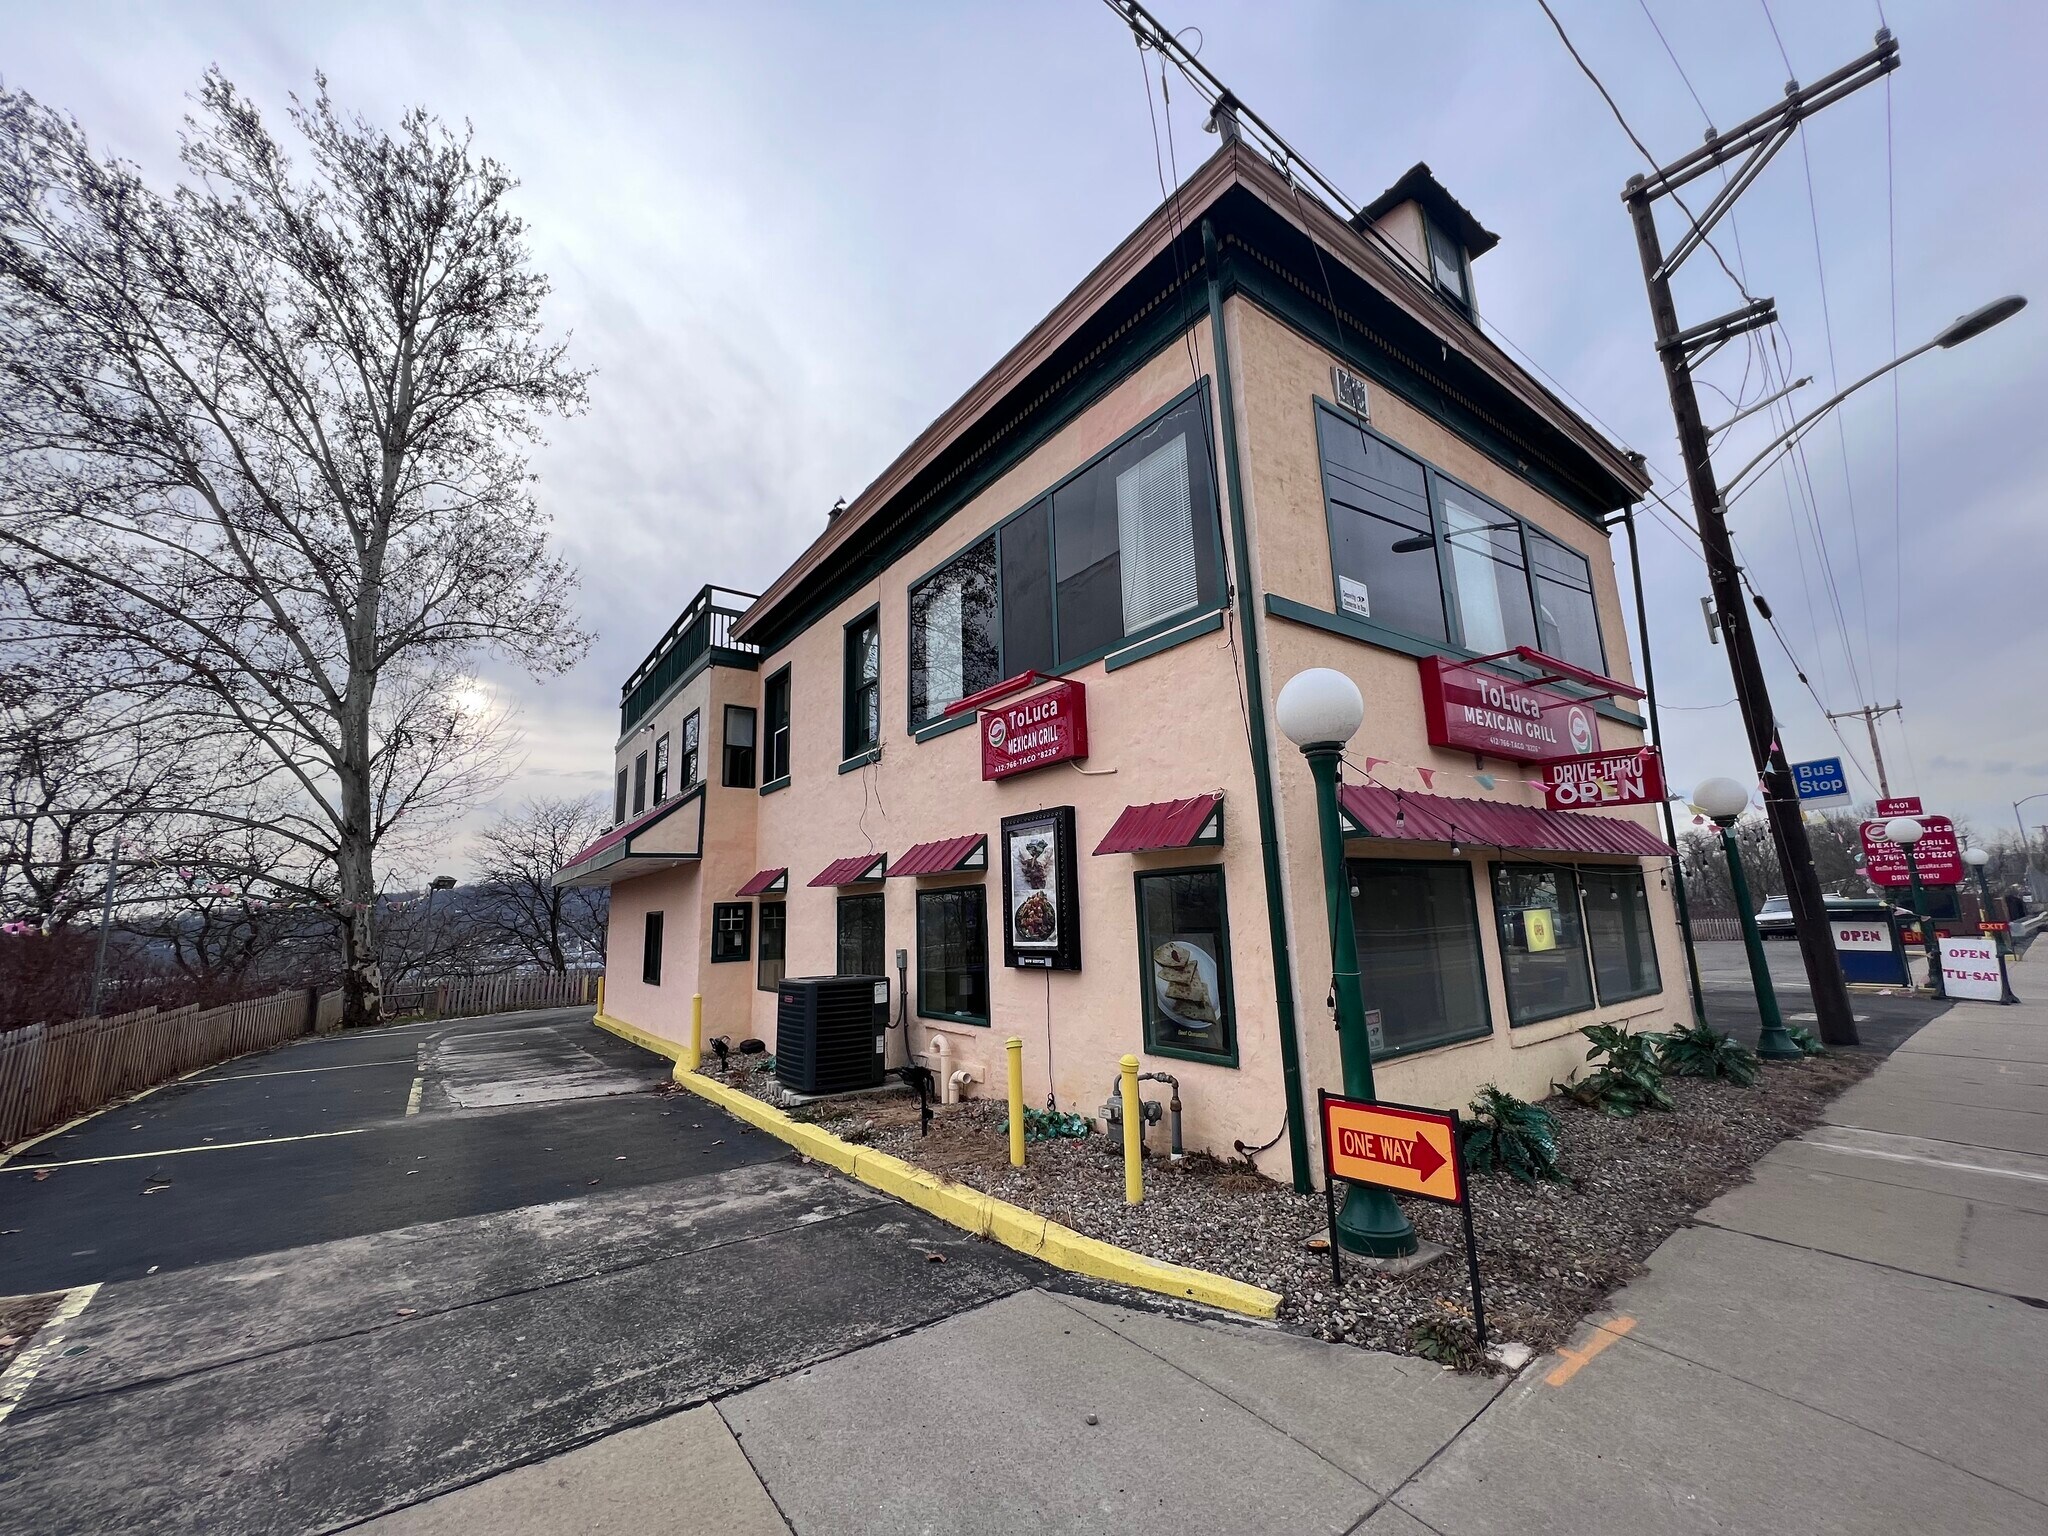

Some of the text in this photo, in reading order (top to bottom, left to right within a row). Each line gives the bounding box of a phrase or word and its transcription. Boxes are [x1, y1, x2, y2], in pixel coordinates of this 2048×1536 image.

[1464, 705, 1557, 744] MEXICAN GRILL
[1008, 725, 1058, 755] MEXICAN GRILL
[995, 746, 1060, 773] 412-766-TACO "8226"
[1553, 756, 1643, 784] DRIVE-THRU
[1798, 765, 1835, 778] Bus
[1555, 777, 1645, 804] OPEN
[1800, 779, 1843, 793] Stop
[1927, 851, 1957, 859] "8226"
[1840, 930, 1881, 942] OPEN
[1949, 949, 1990, 959] OPEN
[1942, 969, 1999, 982] TU-SAT
[1343, 1131, 1414, 1165] ONE WAY
